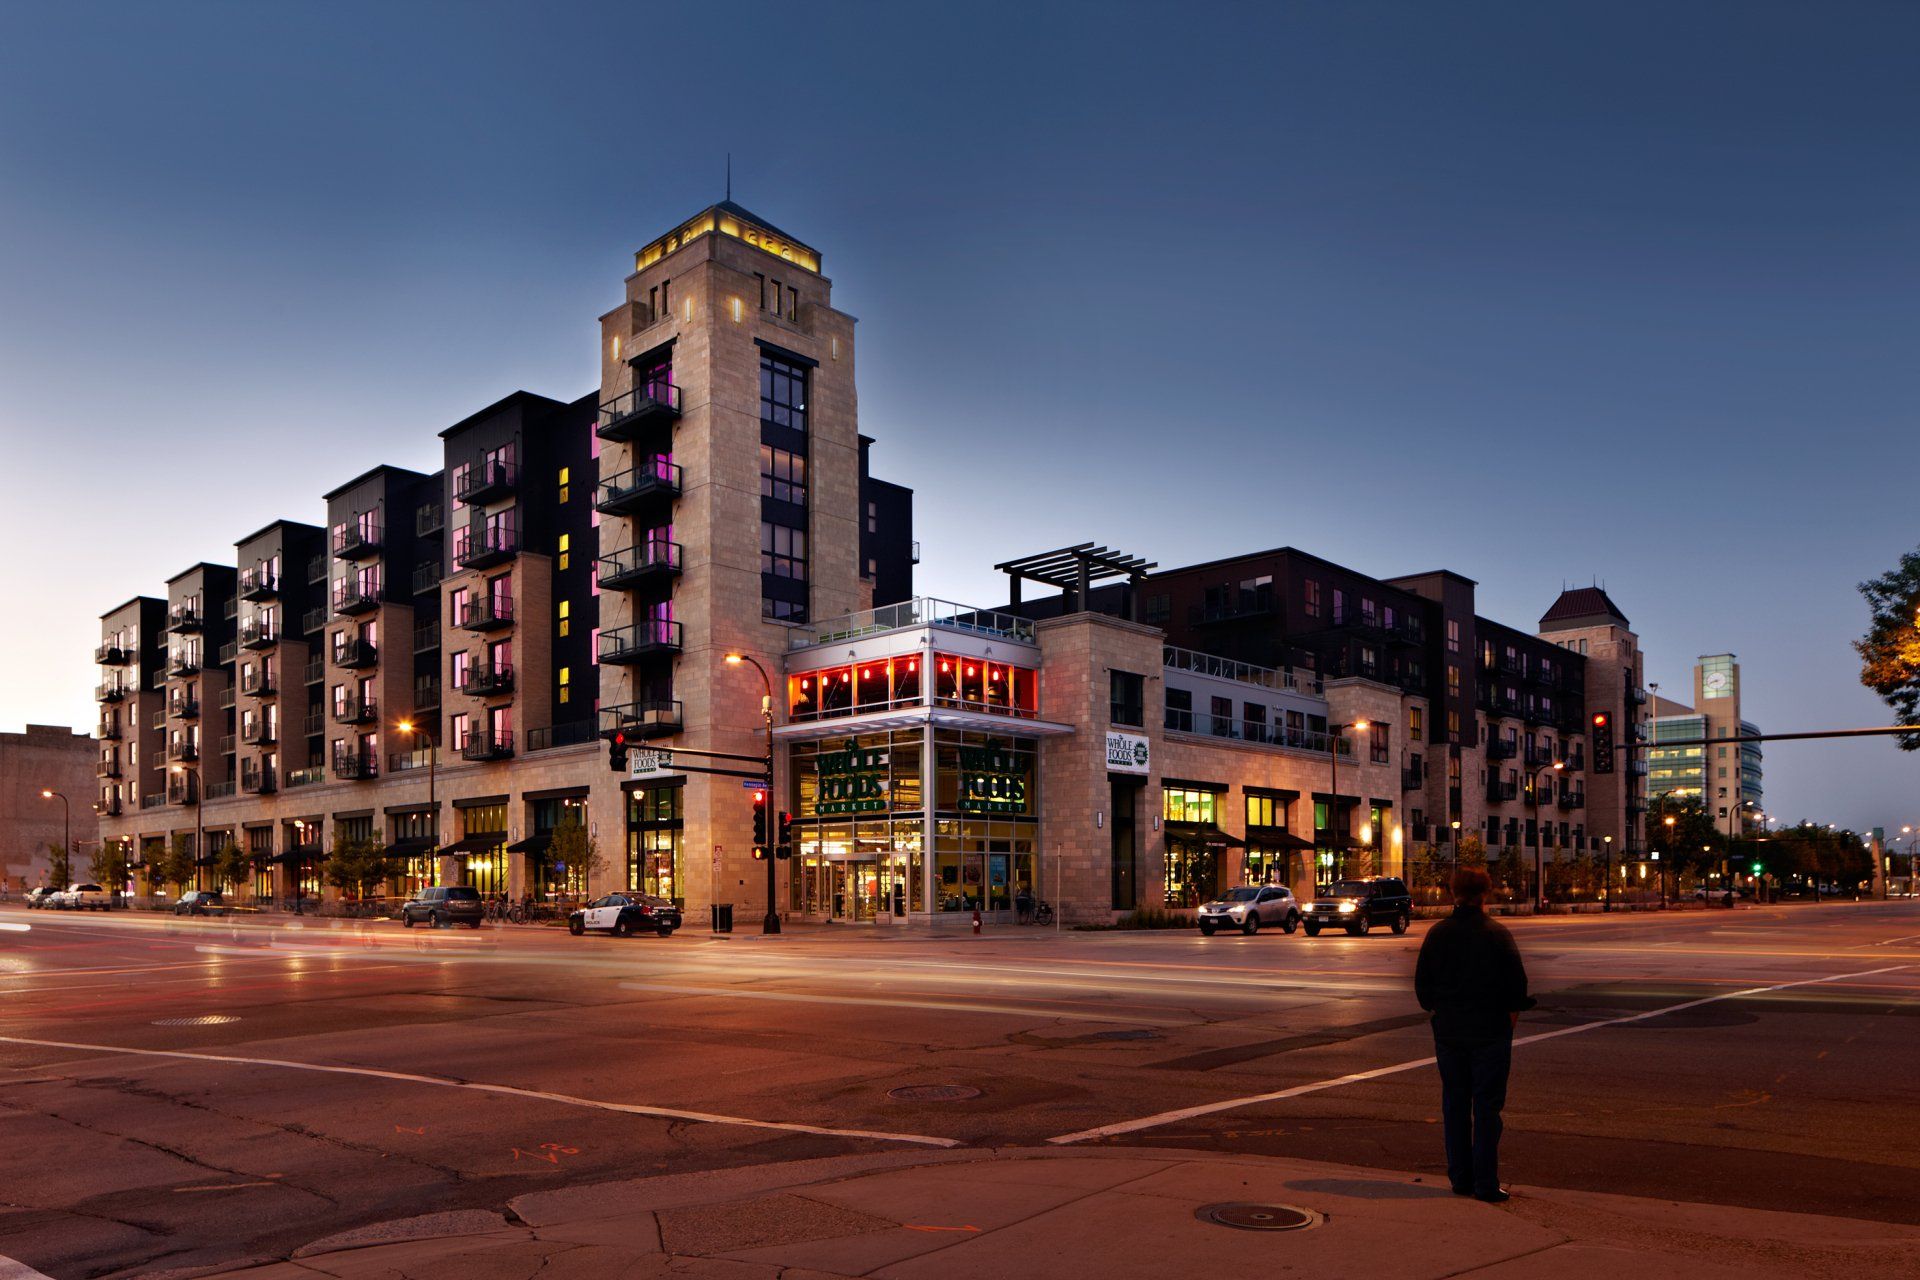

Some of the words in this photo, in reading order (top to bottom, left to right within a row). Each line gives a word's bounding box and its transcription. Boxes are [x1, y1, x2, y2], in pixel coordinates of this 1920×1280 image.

[1107, 738, 1132, 750] WHOLE
[632, 748, 656, 759] WHOLE
[1108, 749, 1132, 761] FOODS
[634, 757, 656, 768] FOODS
[816, 749, 888, 774] WHOLE
[960, 746, 1027, 774] WHOLE
[819, 774, 882, 801] FOODS
[961, 773, 1025, 800] FOODS
[820, 801, 878, 812] MARKET
[964, 801, 1022, 810] MARKET
